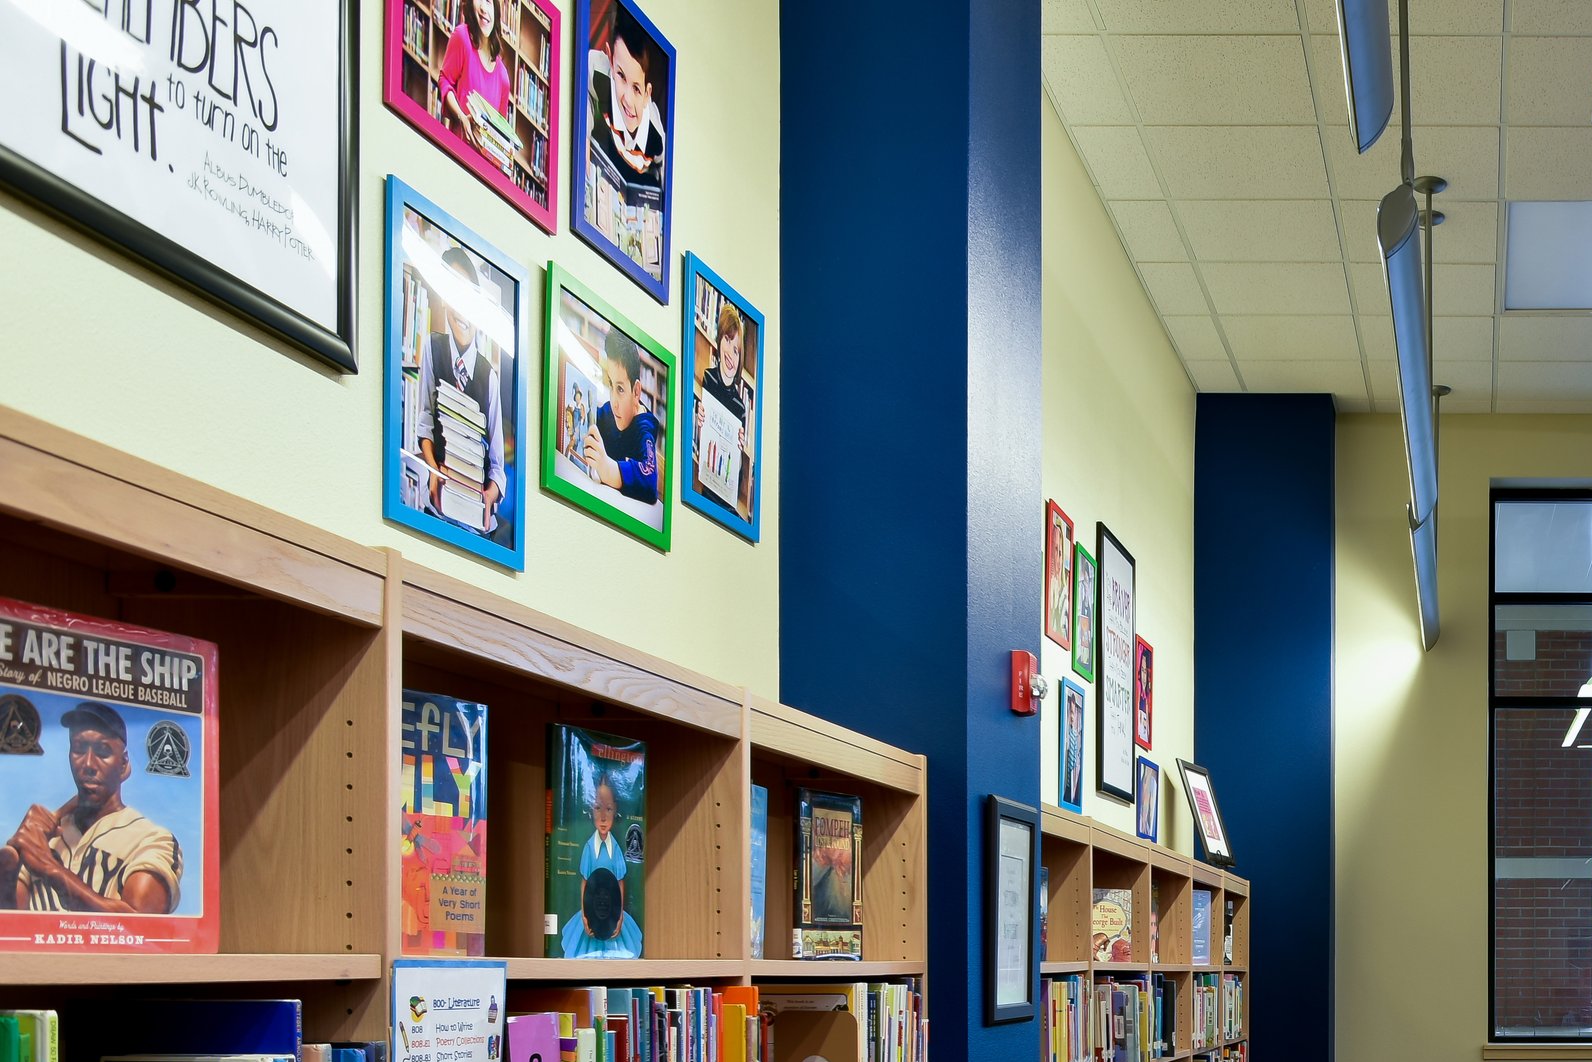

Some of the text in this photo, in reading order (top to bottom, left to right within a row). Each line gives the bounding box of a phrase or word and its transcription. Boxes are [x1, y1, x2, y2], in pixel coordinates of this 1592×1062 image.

[166, 72, 185, 110] to
[193, 90, 235, 143] turn
[241, 121, 260, 159] on
[238, 172, 295, 225] DUMBLEDO
[251, 208, 285, 247] HARRY
[283, 226, 315, 261] POTTER
[0, 623, 198, 692] E ARE THE SHIP
[47, 671, 89, 692] NEGRO
[92, 679, 135, 701] LEAGUE
[138, 685, 188, 709] BASEBALL
[442, 886, 478, 897] A Year of
[438, 897, 481, 912] Very Short
[1099, 905, 1117, 914] House
[445, 909, 475, 922] Poems
[1092, 917, 1123, 928] eorge Built
[34, 933, 145, 946] KADIR NELSON
[435, 1023, 450, 1034] How
[449, 1023, 457, 1031] to
[457, 1021, 474, 1033] Write
[435, 1037, 455, 1048] Poetry
[436, 1051, 453, 1062] Short
[454, 1050, 473, 1061] Stories
